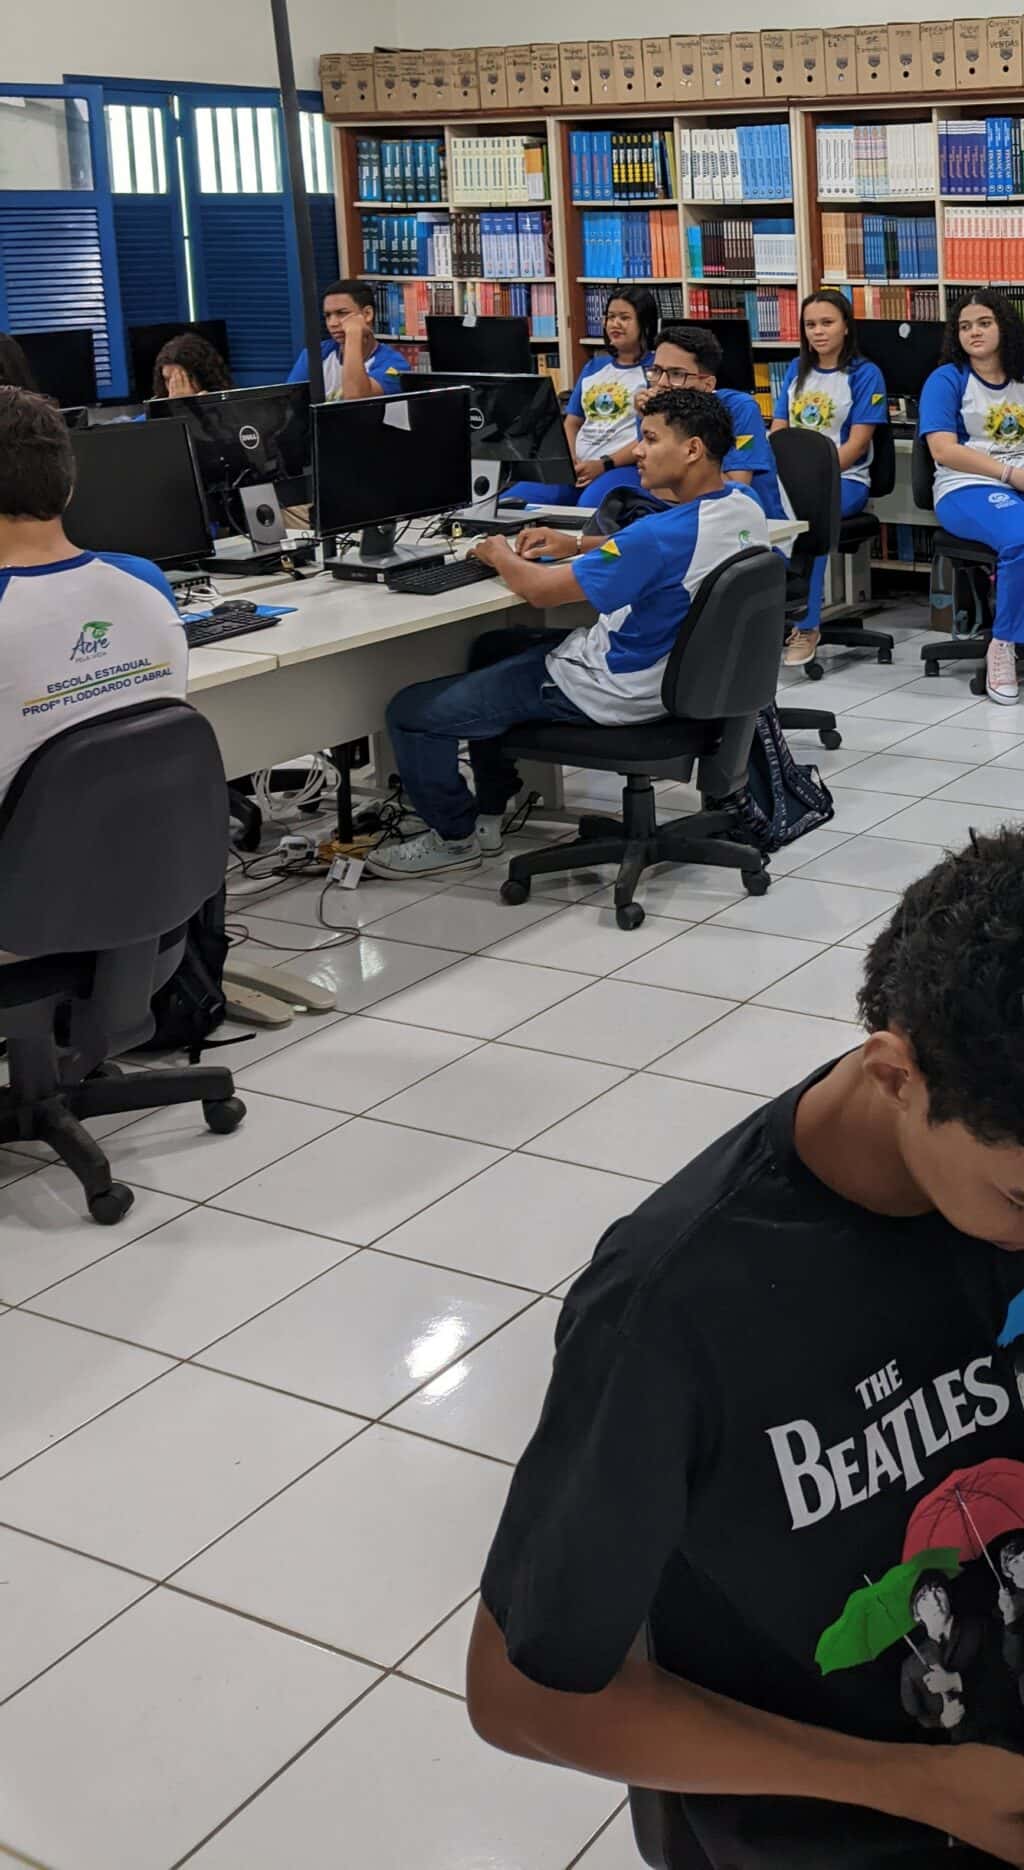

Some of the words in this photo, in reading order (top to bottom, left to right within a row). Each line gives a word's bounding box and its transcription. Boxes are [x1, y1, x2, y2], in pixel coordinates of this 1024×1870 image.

[70, 630, 110, 660] Acre
[46, 672, 93, 694] ESCOLA
[94, 658, 152, 679] ESTADUAL
[63, 678, 132, 706] FLODOARDO
[134, 668, 173, 685] CABRAL
[854, 1359, 903, 1411] THE
[764, 1355, 1010, 1531] BEATLES
